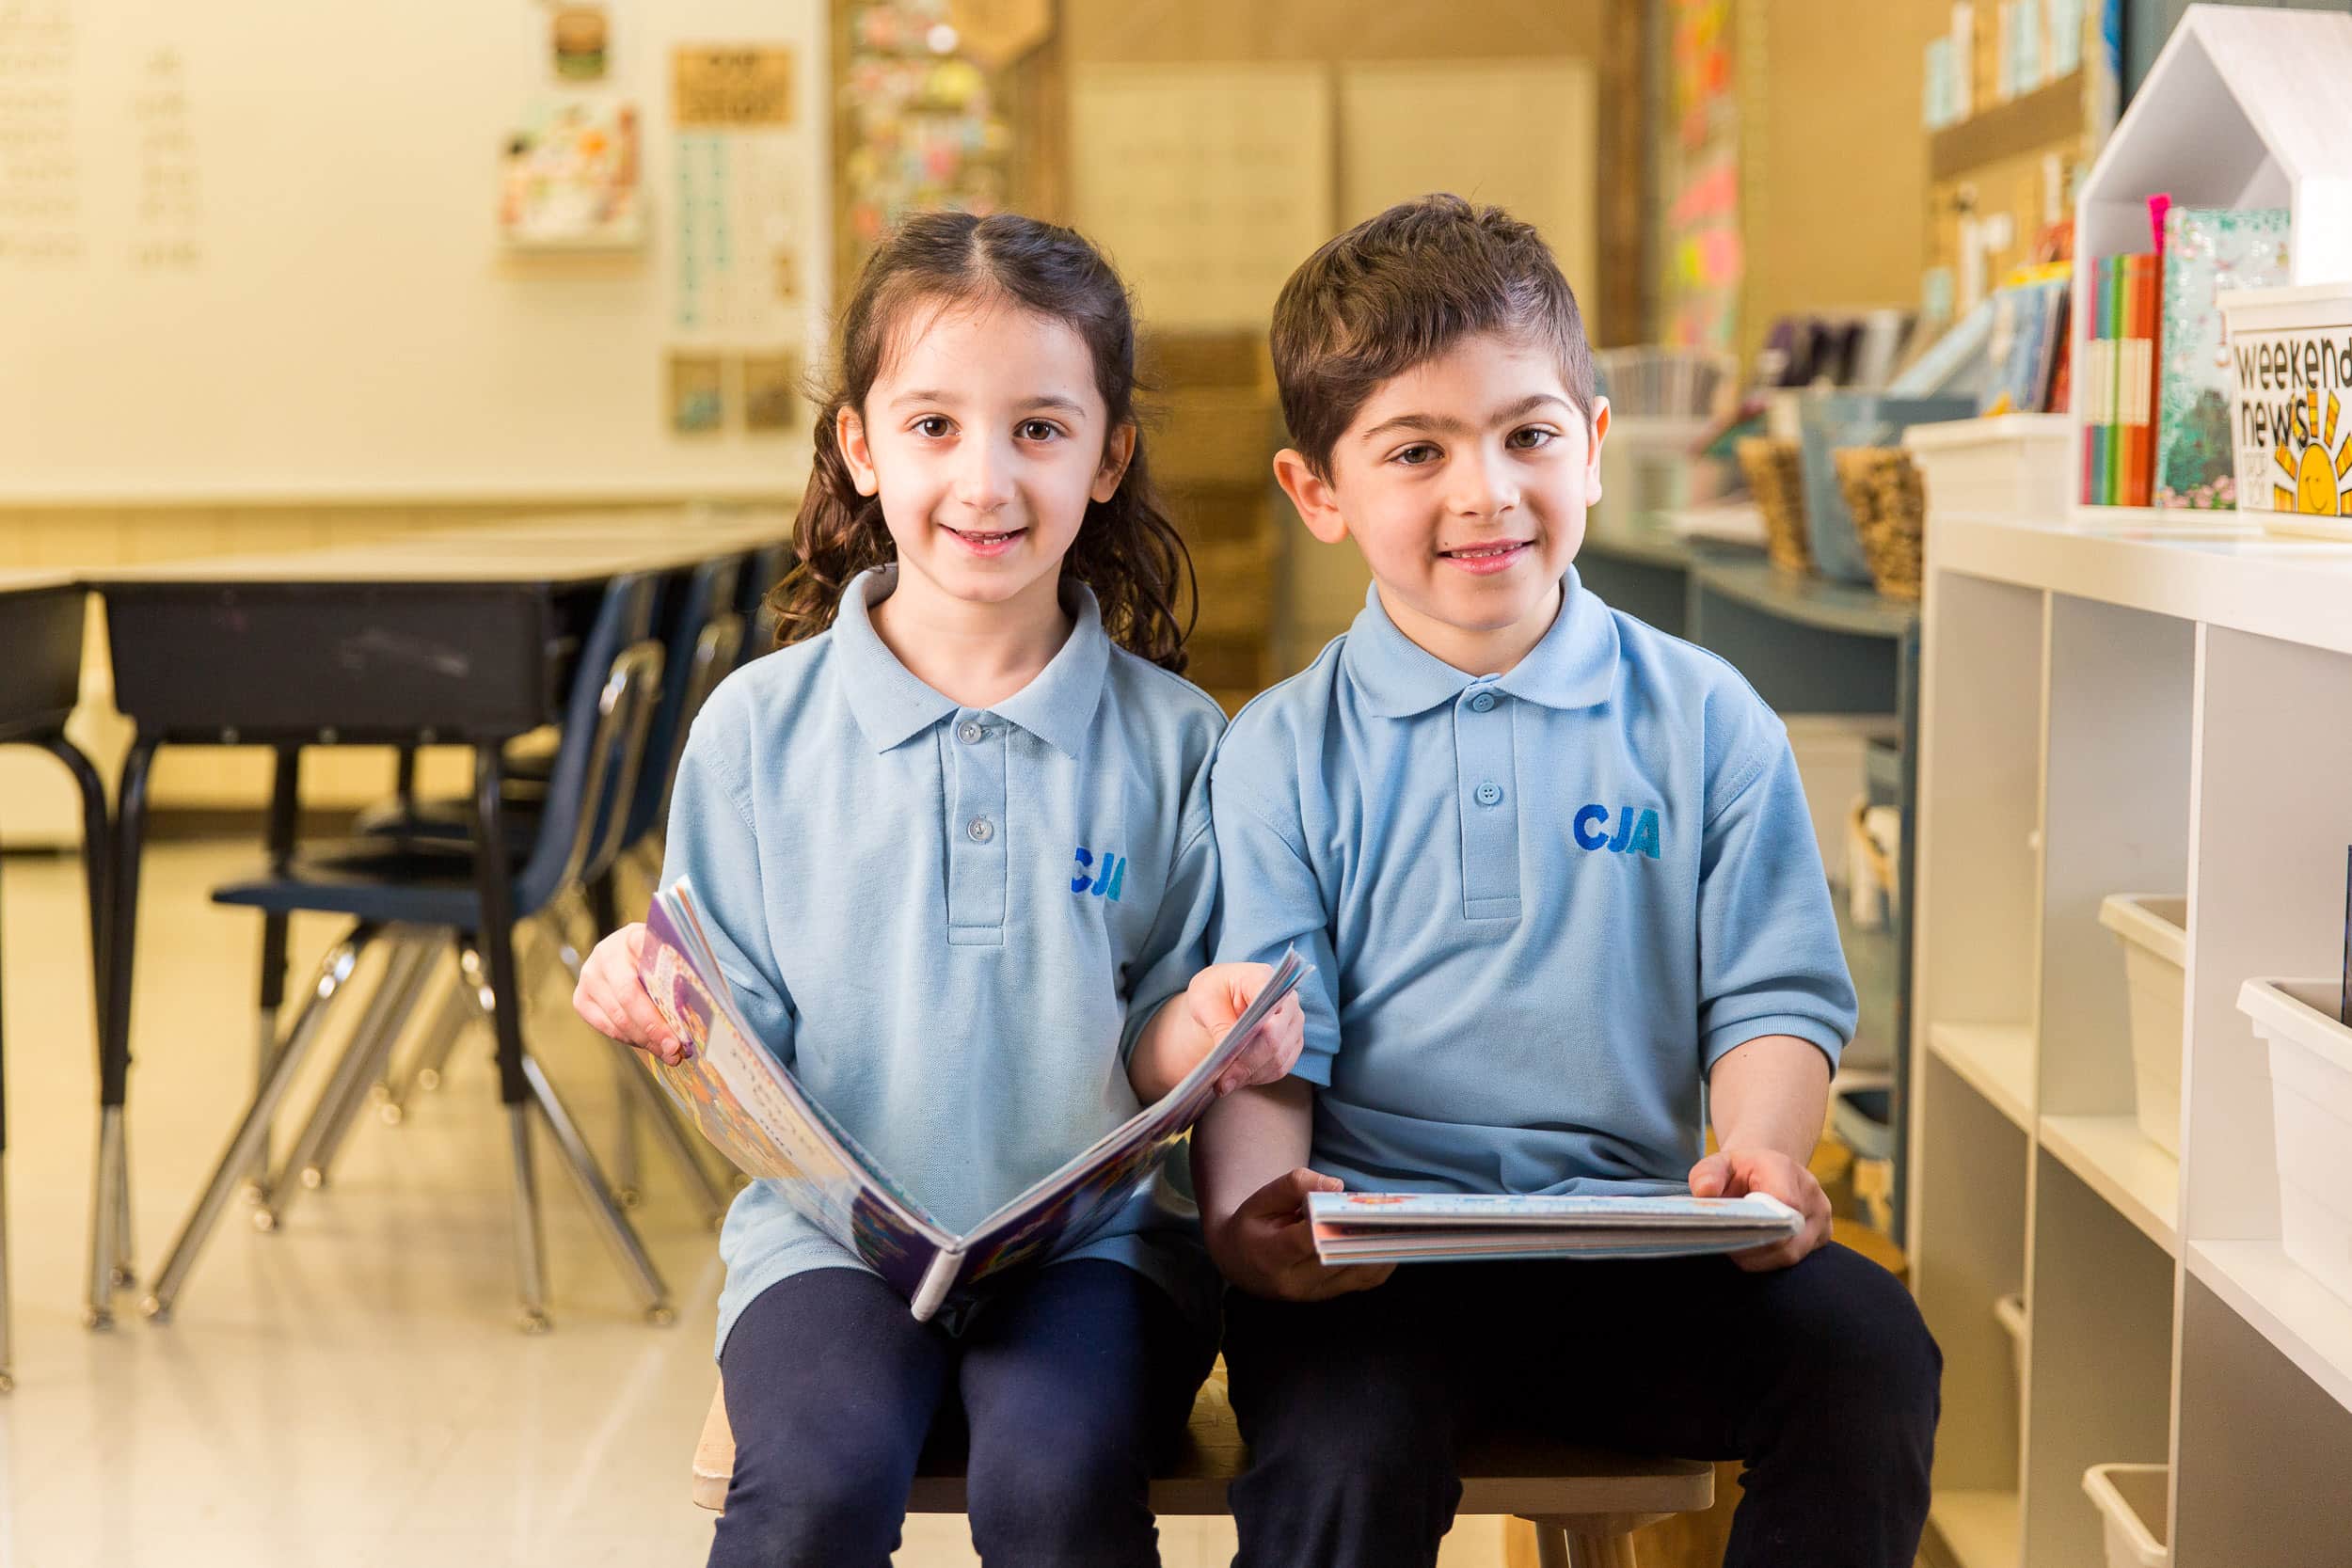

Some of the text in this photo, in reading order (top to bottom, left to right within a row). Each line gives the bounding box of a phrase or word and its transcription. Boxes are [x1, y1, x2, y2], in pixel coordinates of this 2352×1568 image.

[2234, 336, 2352, 389] weekend
[2242, 398, 2309, 449] news
[1573, 803, 1661, 860] CJA
